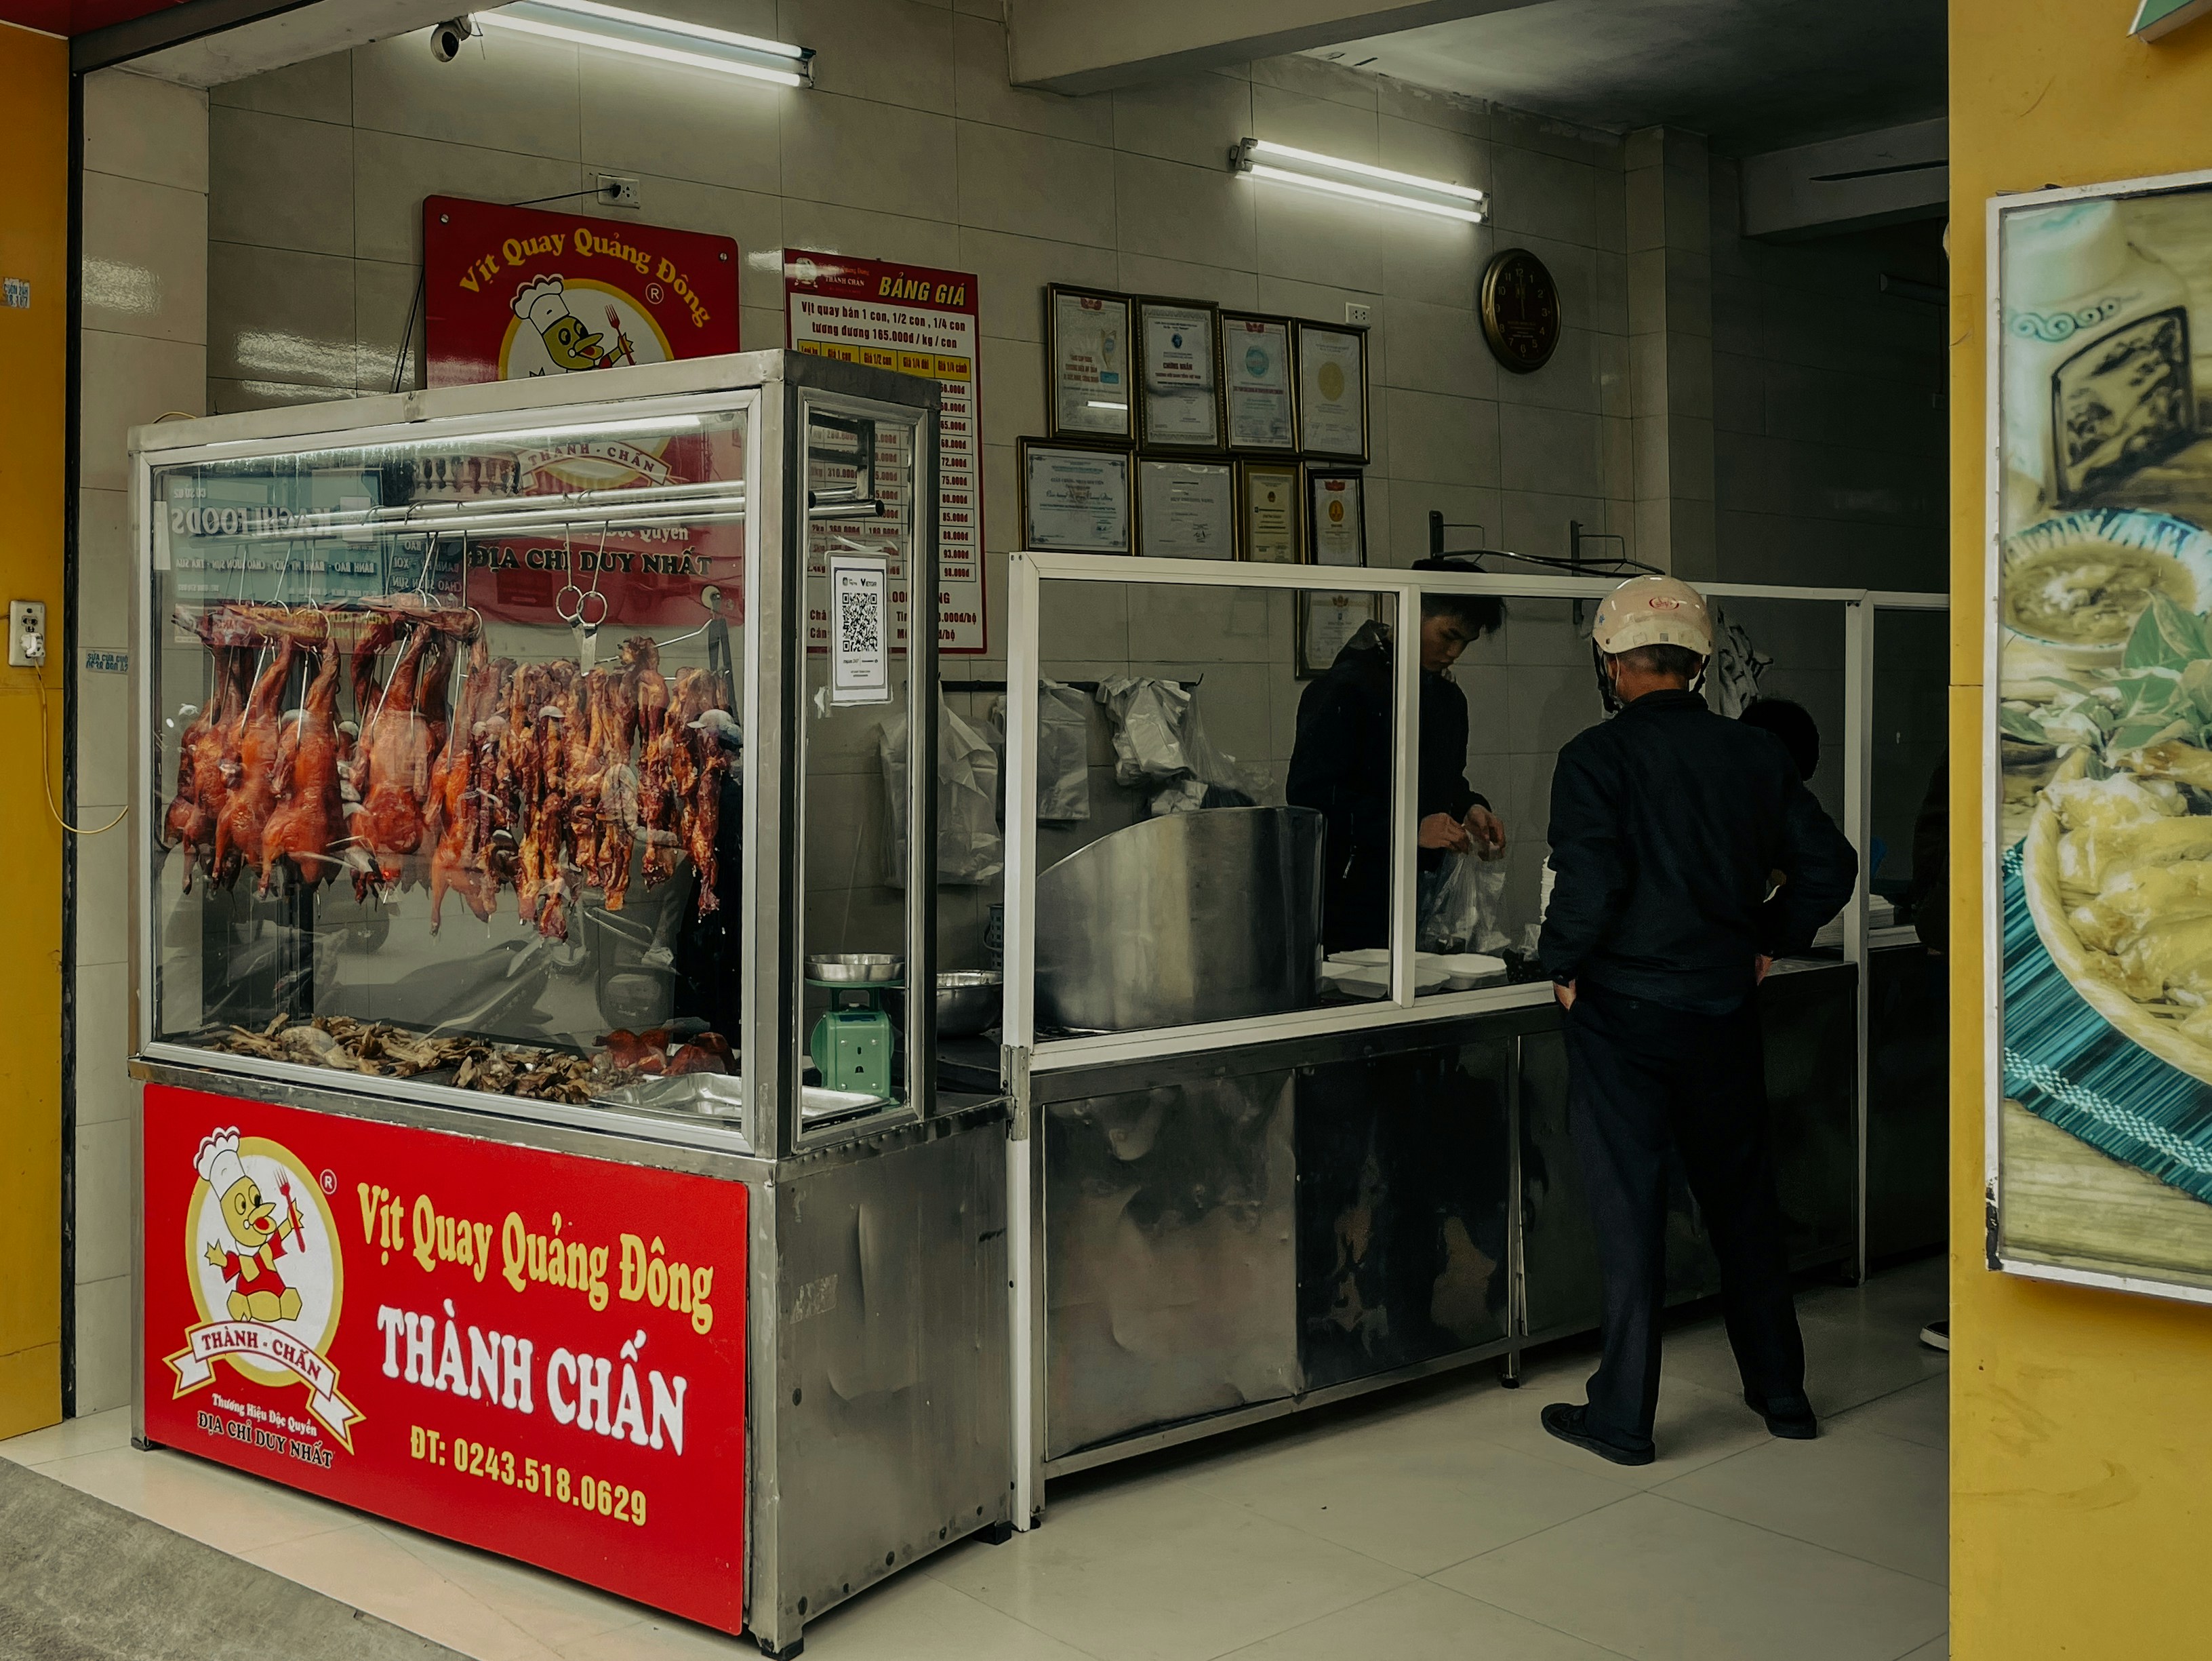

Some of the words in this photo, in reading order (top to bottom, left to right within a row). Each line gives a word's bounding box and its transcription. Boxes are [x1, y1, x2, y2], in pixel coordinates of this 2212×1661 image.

[460, 254, 500, 294] Vịt
[502, 232, 565, 266] Quay
[574, 228, 651, 275] Quảng
[656, 257, 711, 328] Đông
[879, 272, 930, 301] BẢNG
[935, 282, 965, 306] GIÁ
[802, 302, 814, 316] Vịt
[818, 304, 839, 318] quay
[843, 306, 859, 319] bán
[863, 309, 866, 319] 1
[893, 313, 906, 324] 1/2
[910, 316, 925, 327] con
[933, 318, 947, 329] 1/4
[950, 321, 965, 332] con
[922, 334, 933, 346] kg
[941, 338, 957, 348] con
[468, 546, 521, 574] ĐỊA
[525, 541, 574, 571] CHỈ
[579, 549, 636, 574] DUY
[641, 546, 712, 576] NHẤT
[357, 1182, 404, 1266] Vịt
[413, 1194, 493, 1282] Quay
[502, 1212, 609, 1311] Quảng
[619, 1233, 714, 1334] Đông
[202, 1325, 258, 1350] THÀNH
[377, 1298, 534, 1414] THÀNH
[546, 1329, 687, 1456] CHẤN
[212, 1393, 245, 1417] Thương
[247, 1403, 267, 1422] Hiệu
[268, 1409, 286, 1428] Độc
[287, 1416, 317, 1437] Quyền
[198, 1410, 224, 1436] ĐỊA
[227, 1419, 252, 1443] CHỈ
[255, 1428, 287, 1454] DUY
[289, 1441, 334, 1468] NHẤT
[410, 1424, 445, 1466] ĐT:
[454, 1438, 647, 1526] 0243.518.0629
